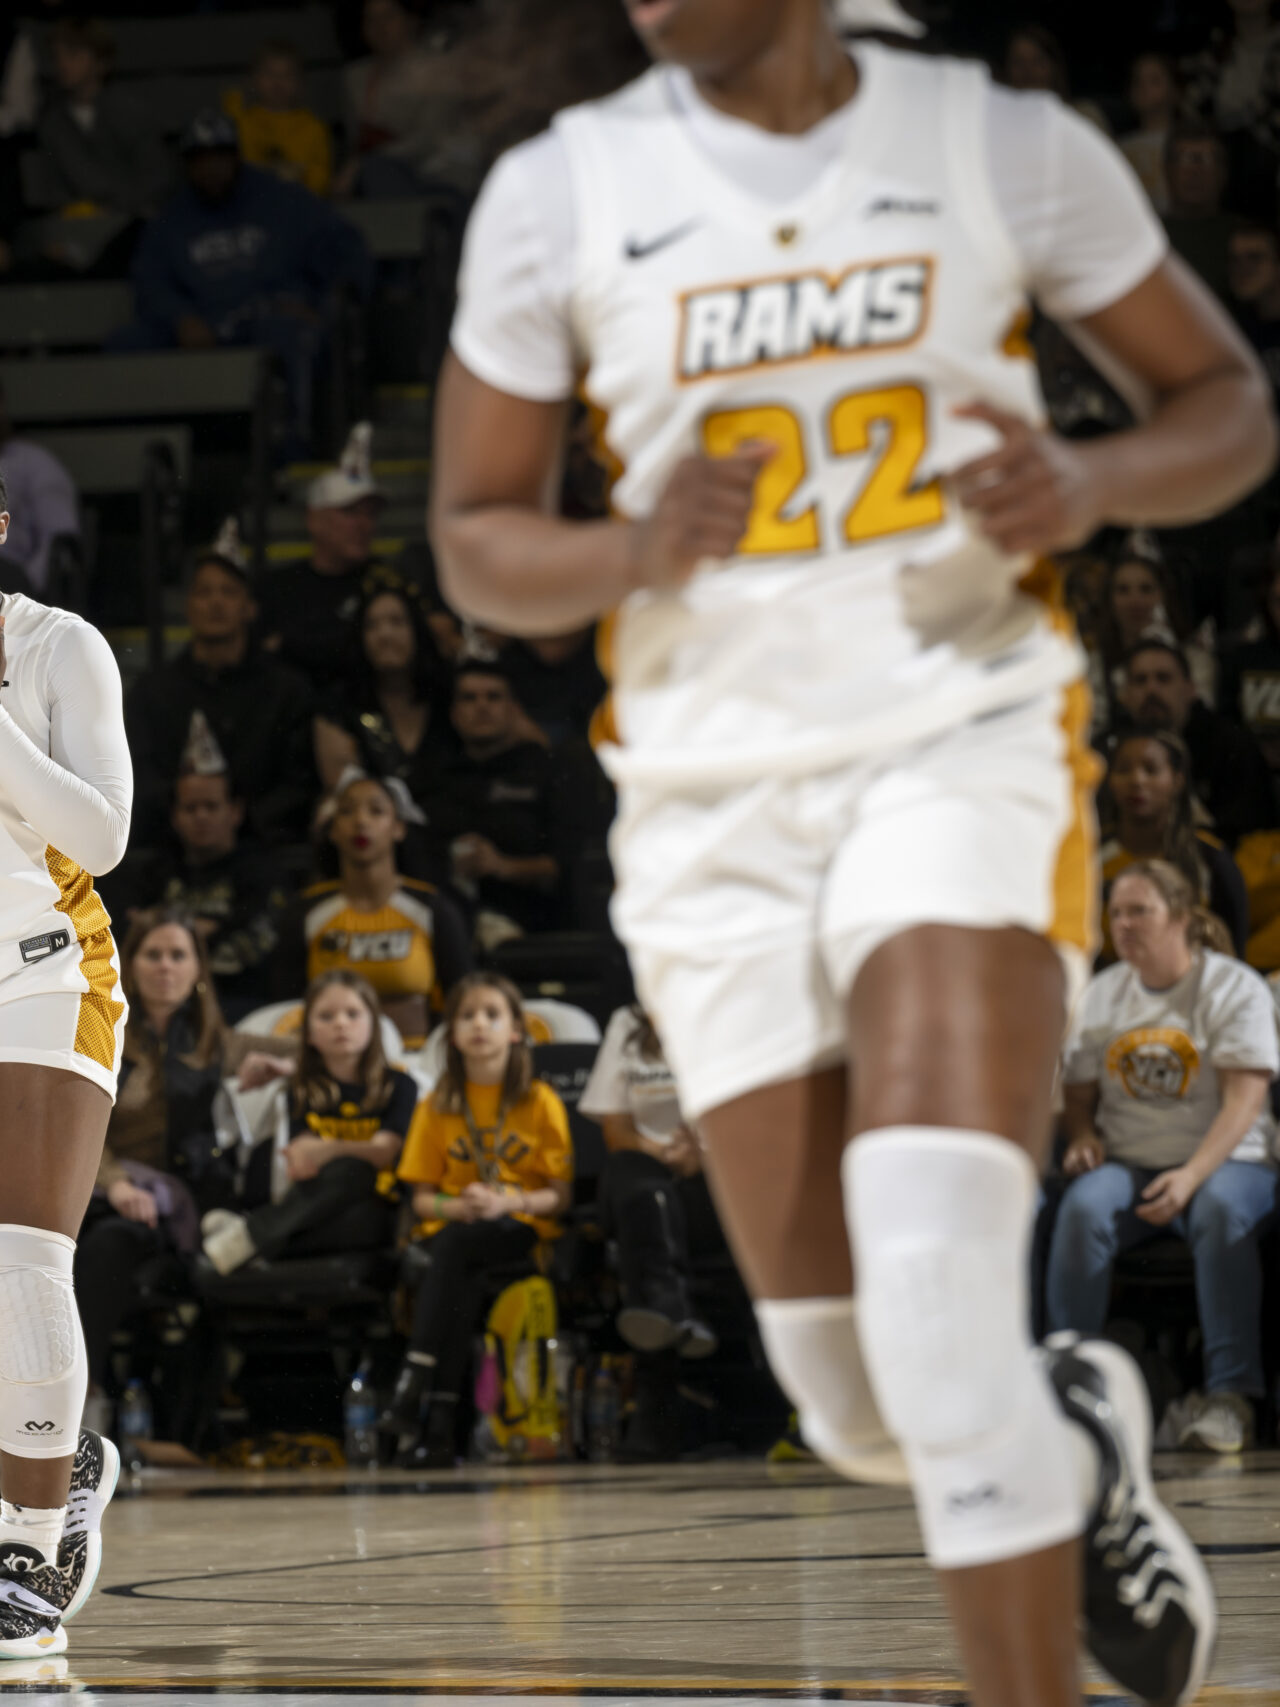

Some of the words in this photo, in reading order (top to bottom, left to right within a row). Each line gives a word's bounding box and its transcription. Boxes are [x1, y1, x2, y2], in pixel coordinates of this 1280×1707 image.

[677, 256, 933, 386] RAMS
[702, 382, 944, 555] 22
[55, 936, 65, 948] M
[347, 928, 413, 962] VCU
